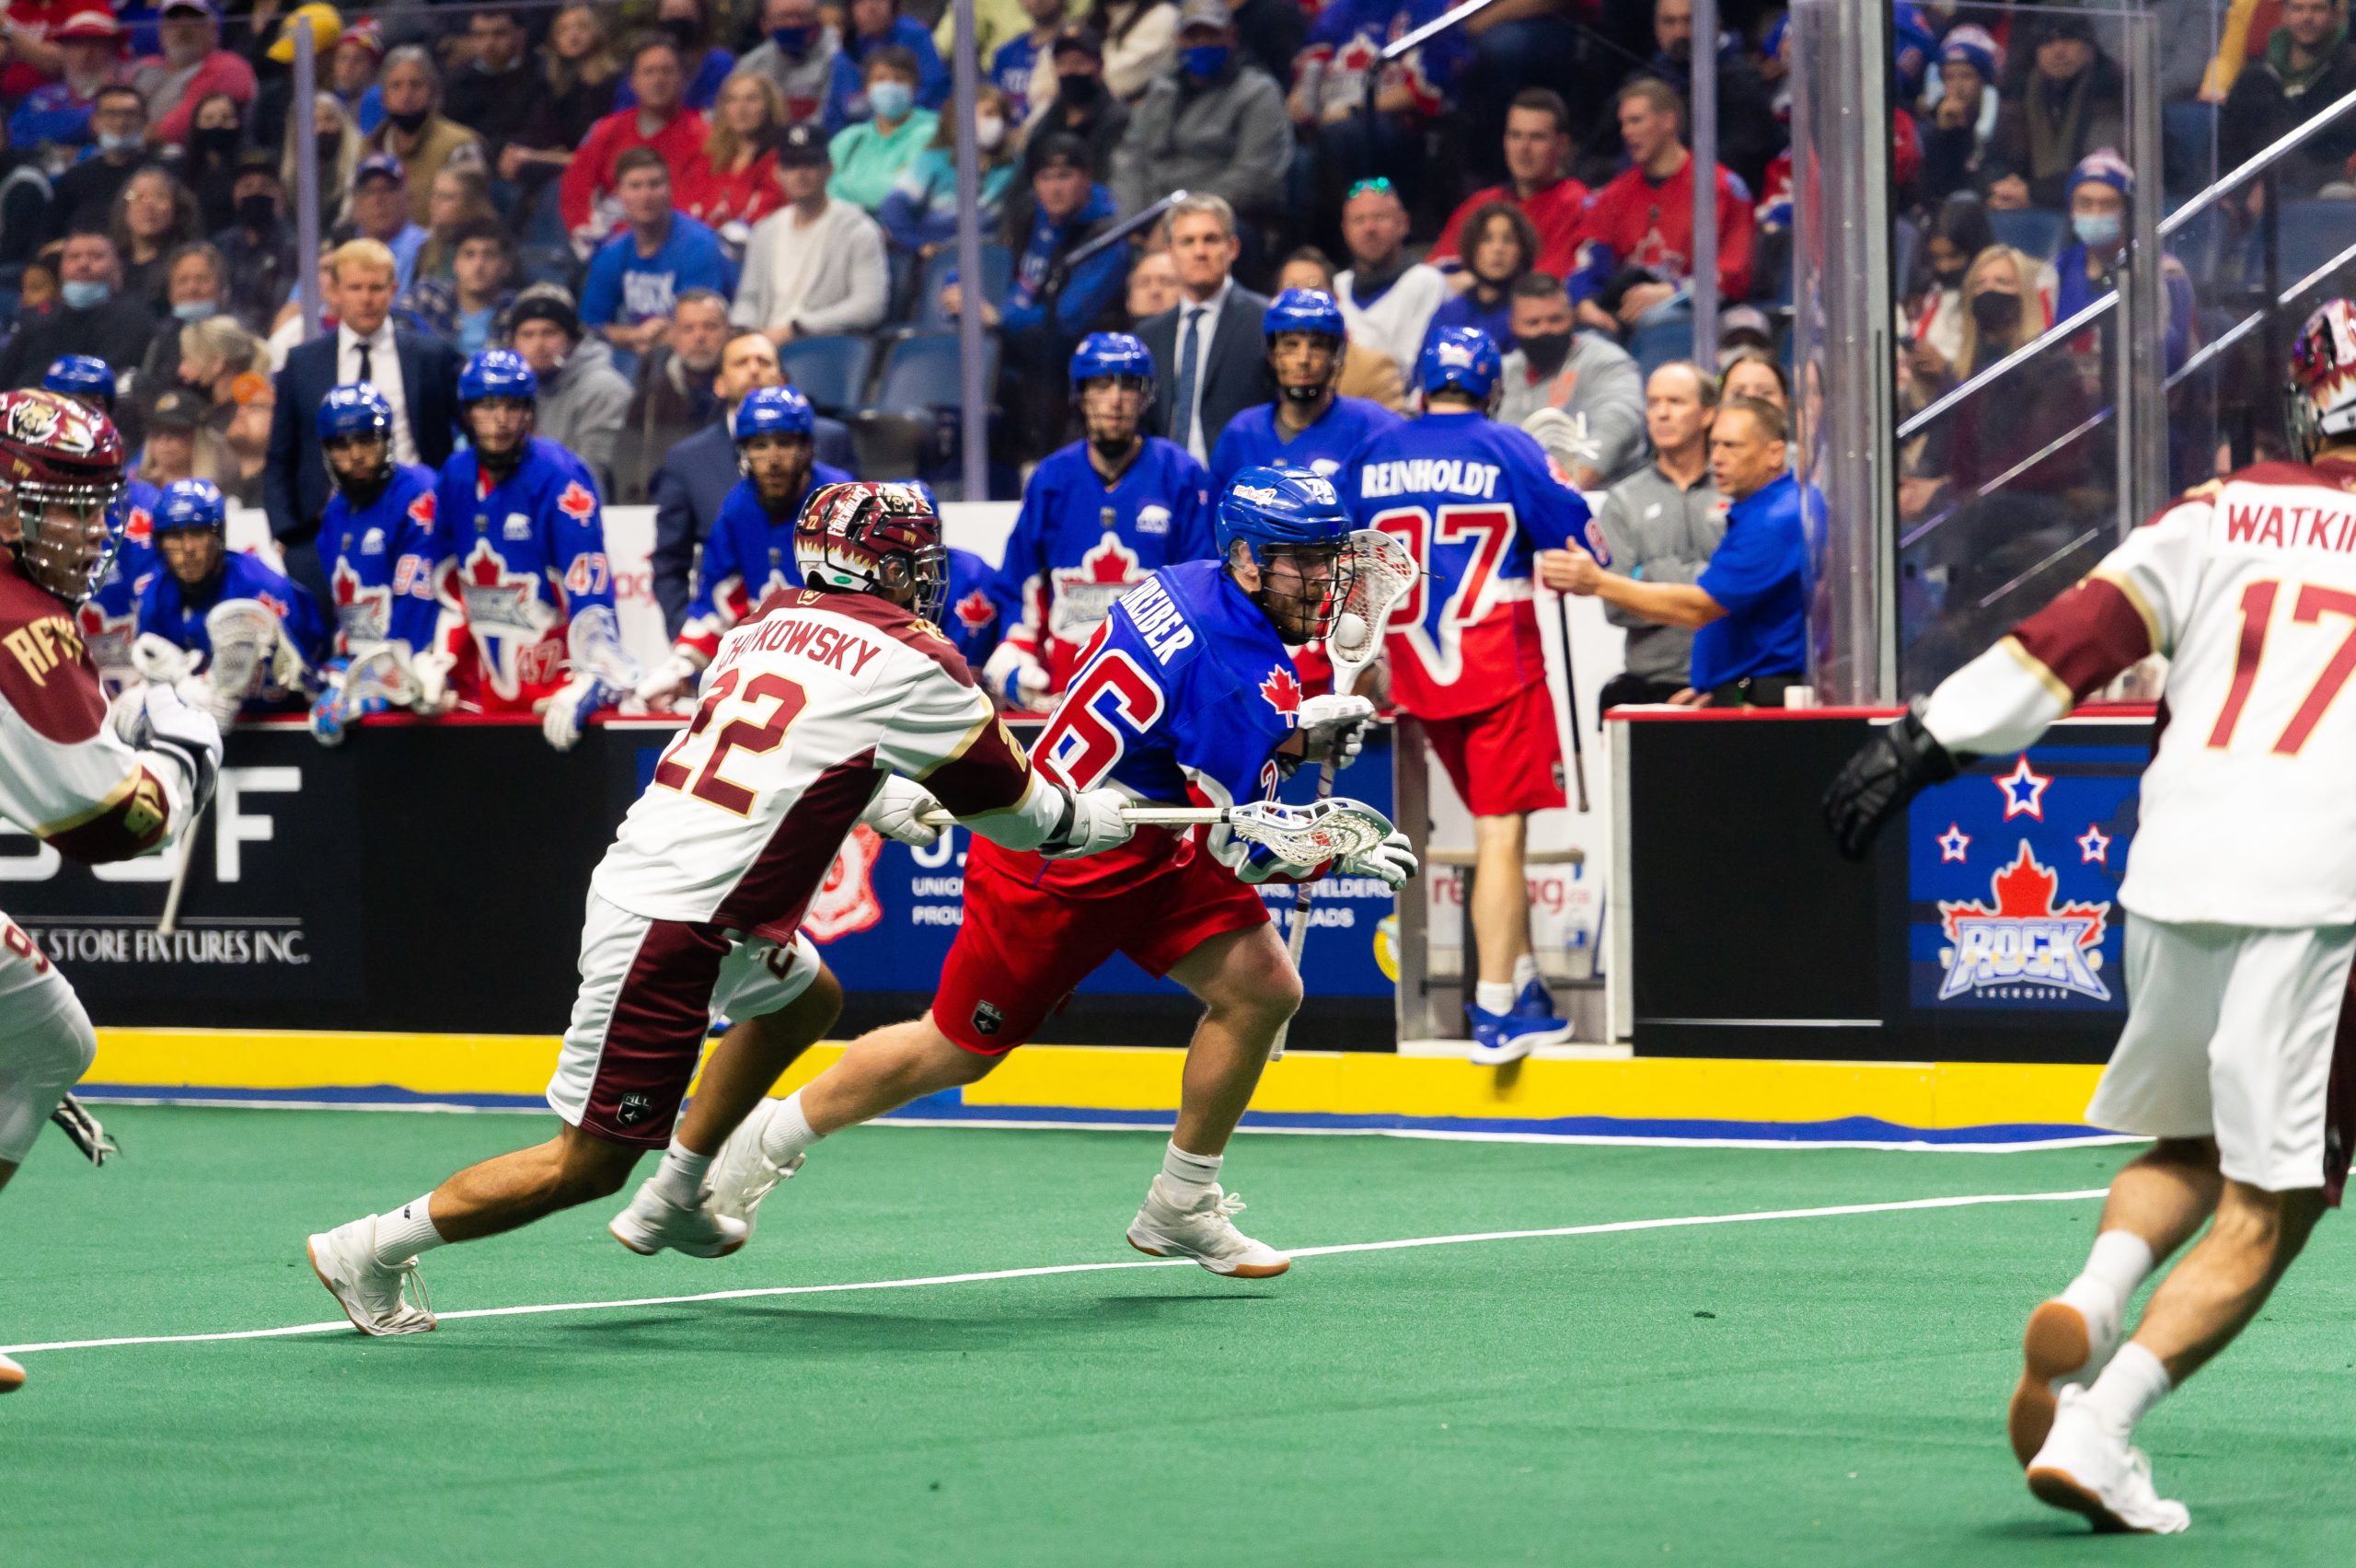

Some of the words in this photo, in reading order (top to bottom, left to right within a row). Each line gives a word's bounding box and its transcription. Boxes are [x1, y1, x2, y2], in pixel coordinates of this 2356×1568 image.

[1360, 459, 1501, 499] REINHOLDT
[564, 552, 608, 596] 47
[2207, 577, 2356, 756] 17
[654, 668, 810, 819] 22
[911, 876, 964, 897] UNIO
[49, 928, 132, 963] STORE
[135, 928, 252, 963] FIXTURES
[255, 928, 311, 963] INC.
[1939, 919, 2111, 1001] ROCK
